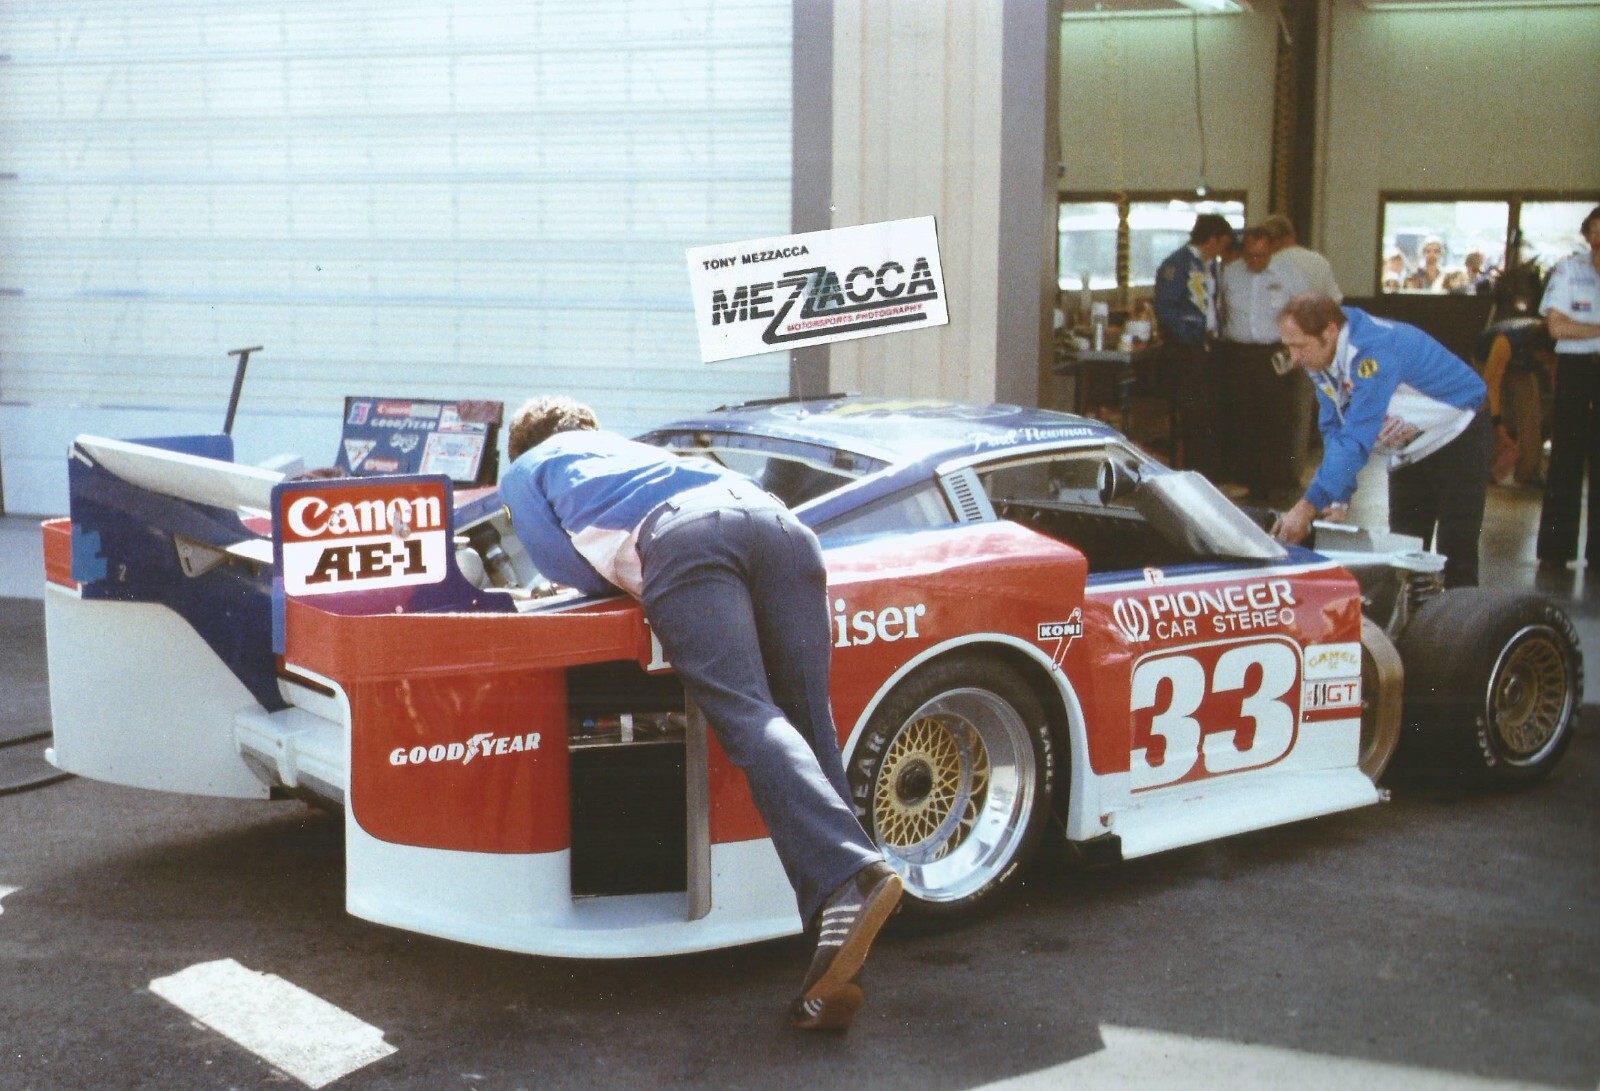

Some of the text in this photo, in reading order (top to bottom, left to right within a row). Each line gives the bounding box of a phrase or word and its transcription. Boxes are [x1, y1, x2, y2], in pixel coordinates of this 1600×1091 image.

[370, 416, 437, 431] GOODYEAR
[288, 495, 441, 538] Canon
[304, 539, 428, 586] AE-1
[1148, 578, 1295, 619] PIONEER
[834, 598, 926, 648] iser
[1041, 624, 1081, 637] KONI
[1155, 607, 1295, 640] CAR STEREO
[1327, 683, 1358, 702] GT
[1130, 641, 1298, 794] 33
[388, 731, 542, 767] GOODYEAR
